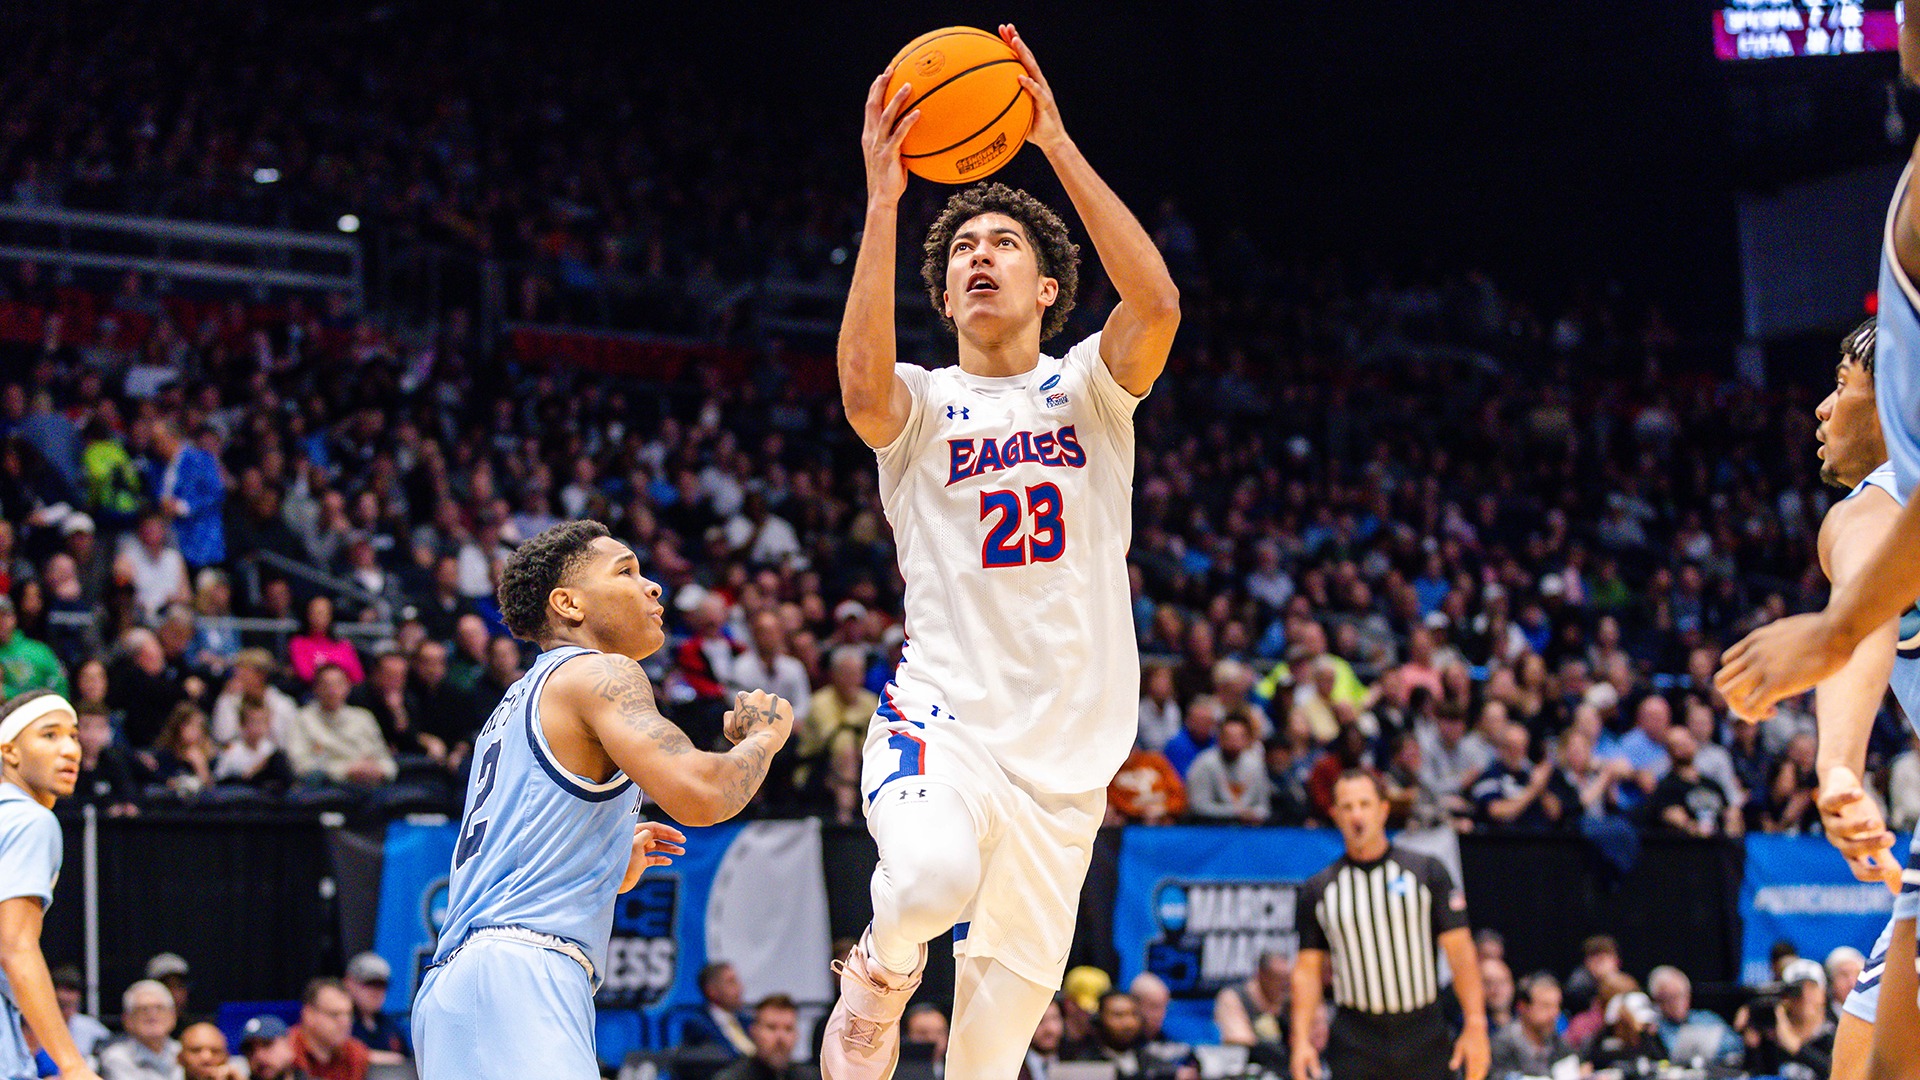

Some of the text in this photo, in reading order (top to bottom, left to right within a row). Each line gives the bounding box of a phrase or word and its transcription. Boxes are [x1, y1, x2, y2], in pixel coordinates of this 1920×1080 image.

[944, 424, 1087, 488] EAGLES
[980, 481, 1066, 569] 23
[454, 736, 503, 874] 2
[1187, 886, 1297, 931] MARCH
[606, 937, 674, 989] ESS
